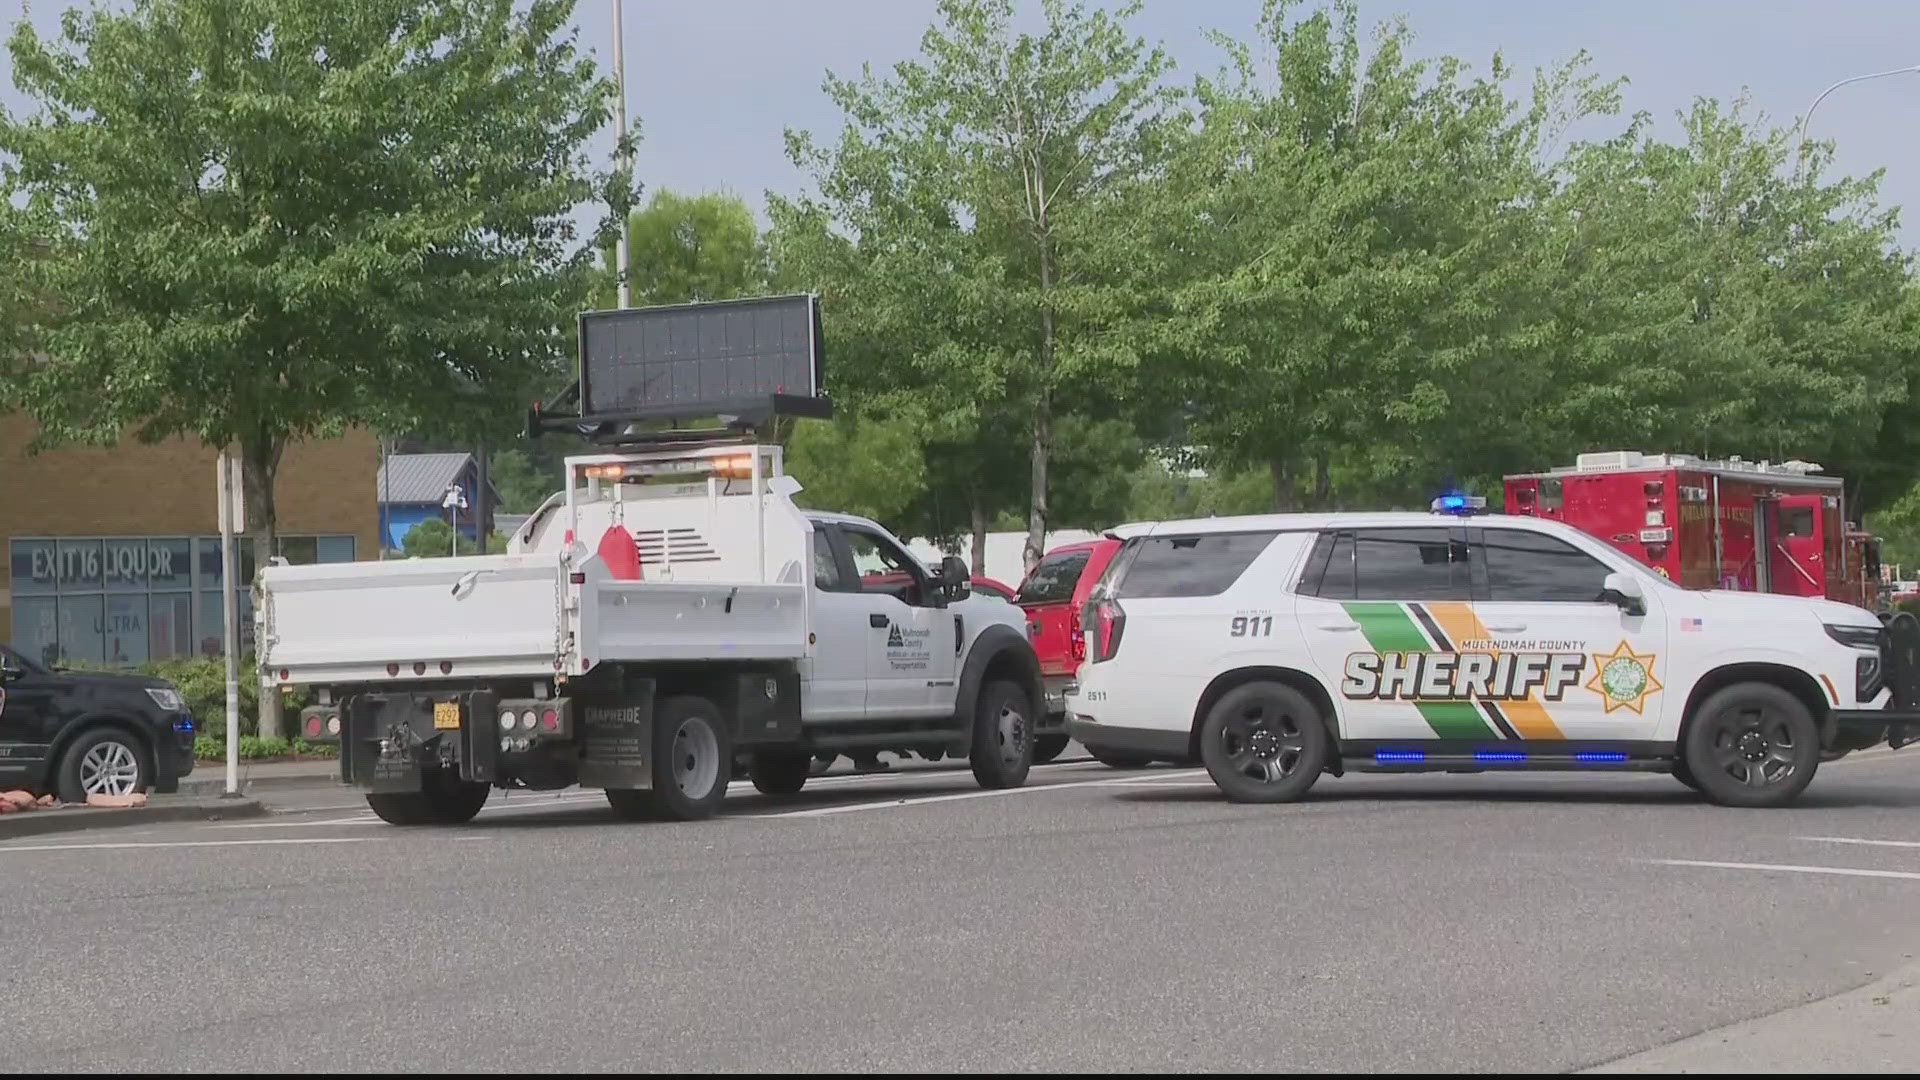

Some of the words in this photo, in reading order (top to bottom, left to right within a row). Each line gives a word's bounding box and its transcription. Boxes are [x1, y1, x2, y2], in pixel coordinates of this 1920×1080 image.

[32, 548, 77, 578] EXIT
[80, 548, 98, 577] 16
[105, 547, 173, 579] LIQUOR
[94, 615, 141, 634] ULTRA
[1231, 616, 1272, 637] 911
[1461, 640, 1536, 650] MULTNOMAH
[1538, 640, 1587, 650] COUNTY
[1341, 652, 1587, 701] SHERIFF
[1087, 691, 1107, 701] 2511
